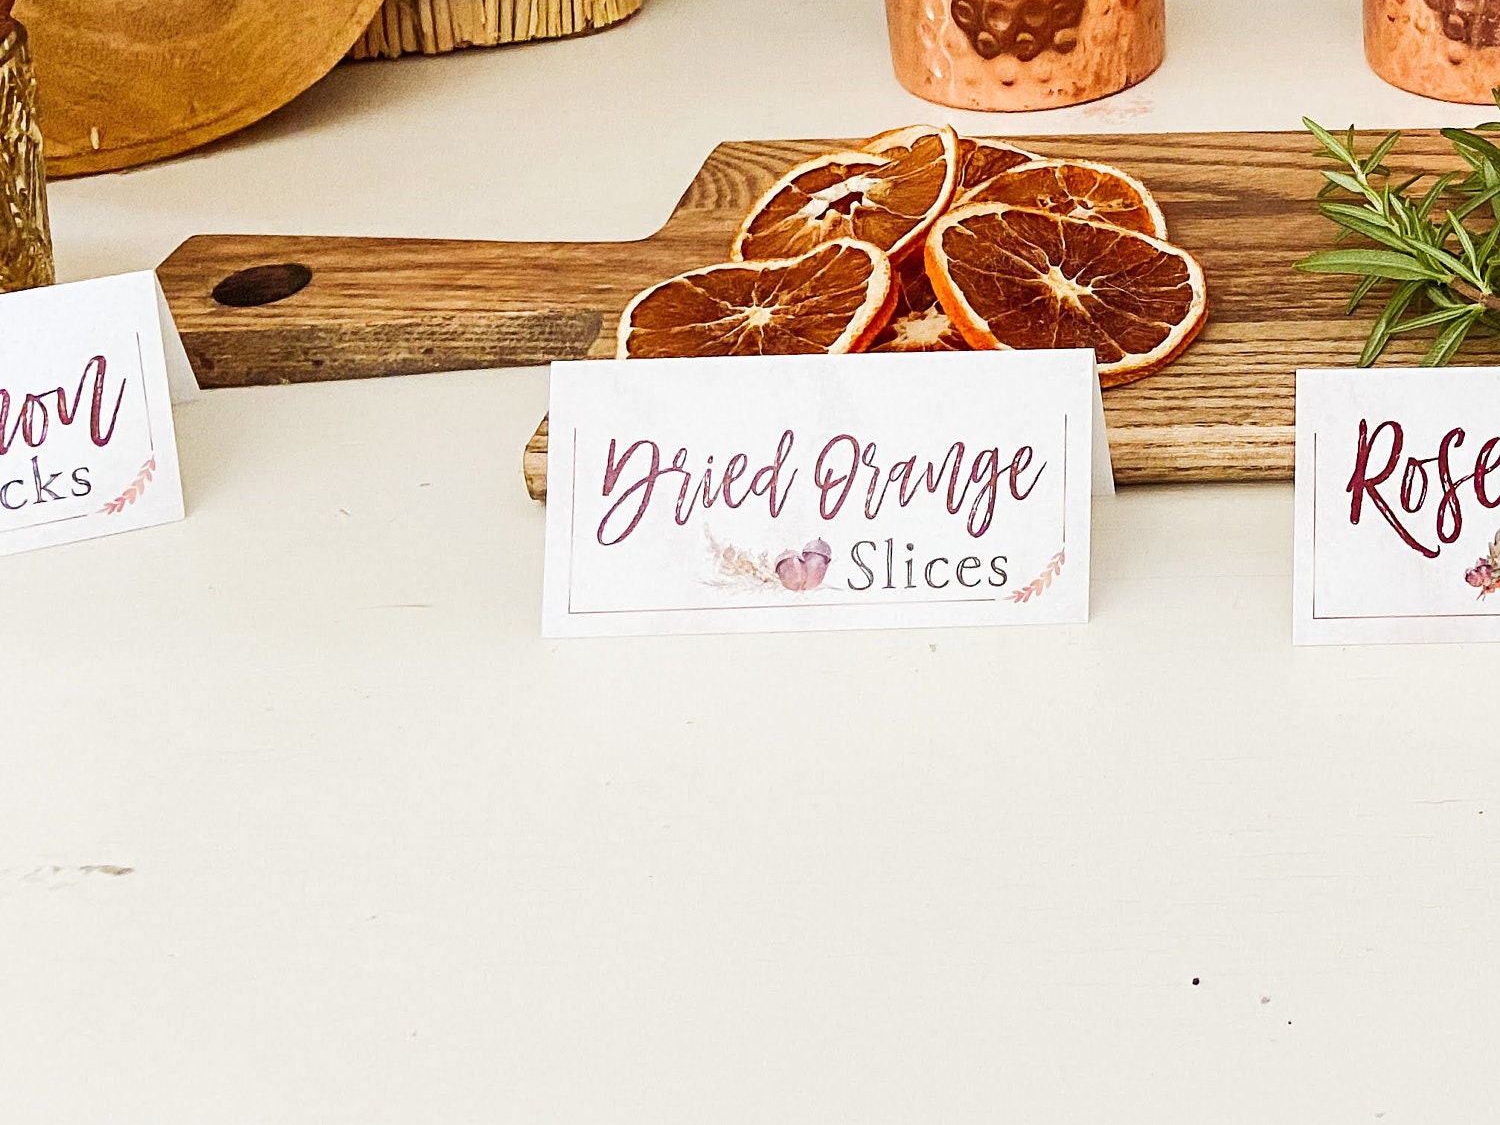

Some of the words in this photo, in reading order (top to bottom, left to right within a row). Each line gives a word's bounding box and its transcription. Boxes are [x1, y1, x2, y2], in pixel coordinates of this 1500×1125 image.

[596, 429, 798, 546] Dried
[814, 433, 1048, 538] Orange
[847, 539, 1009, 591] Slices
